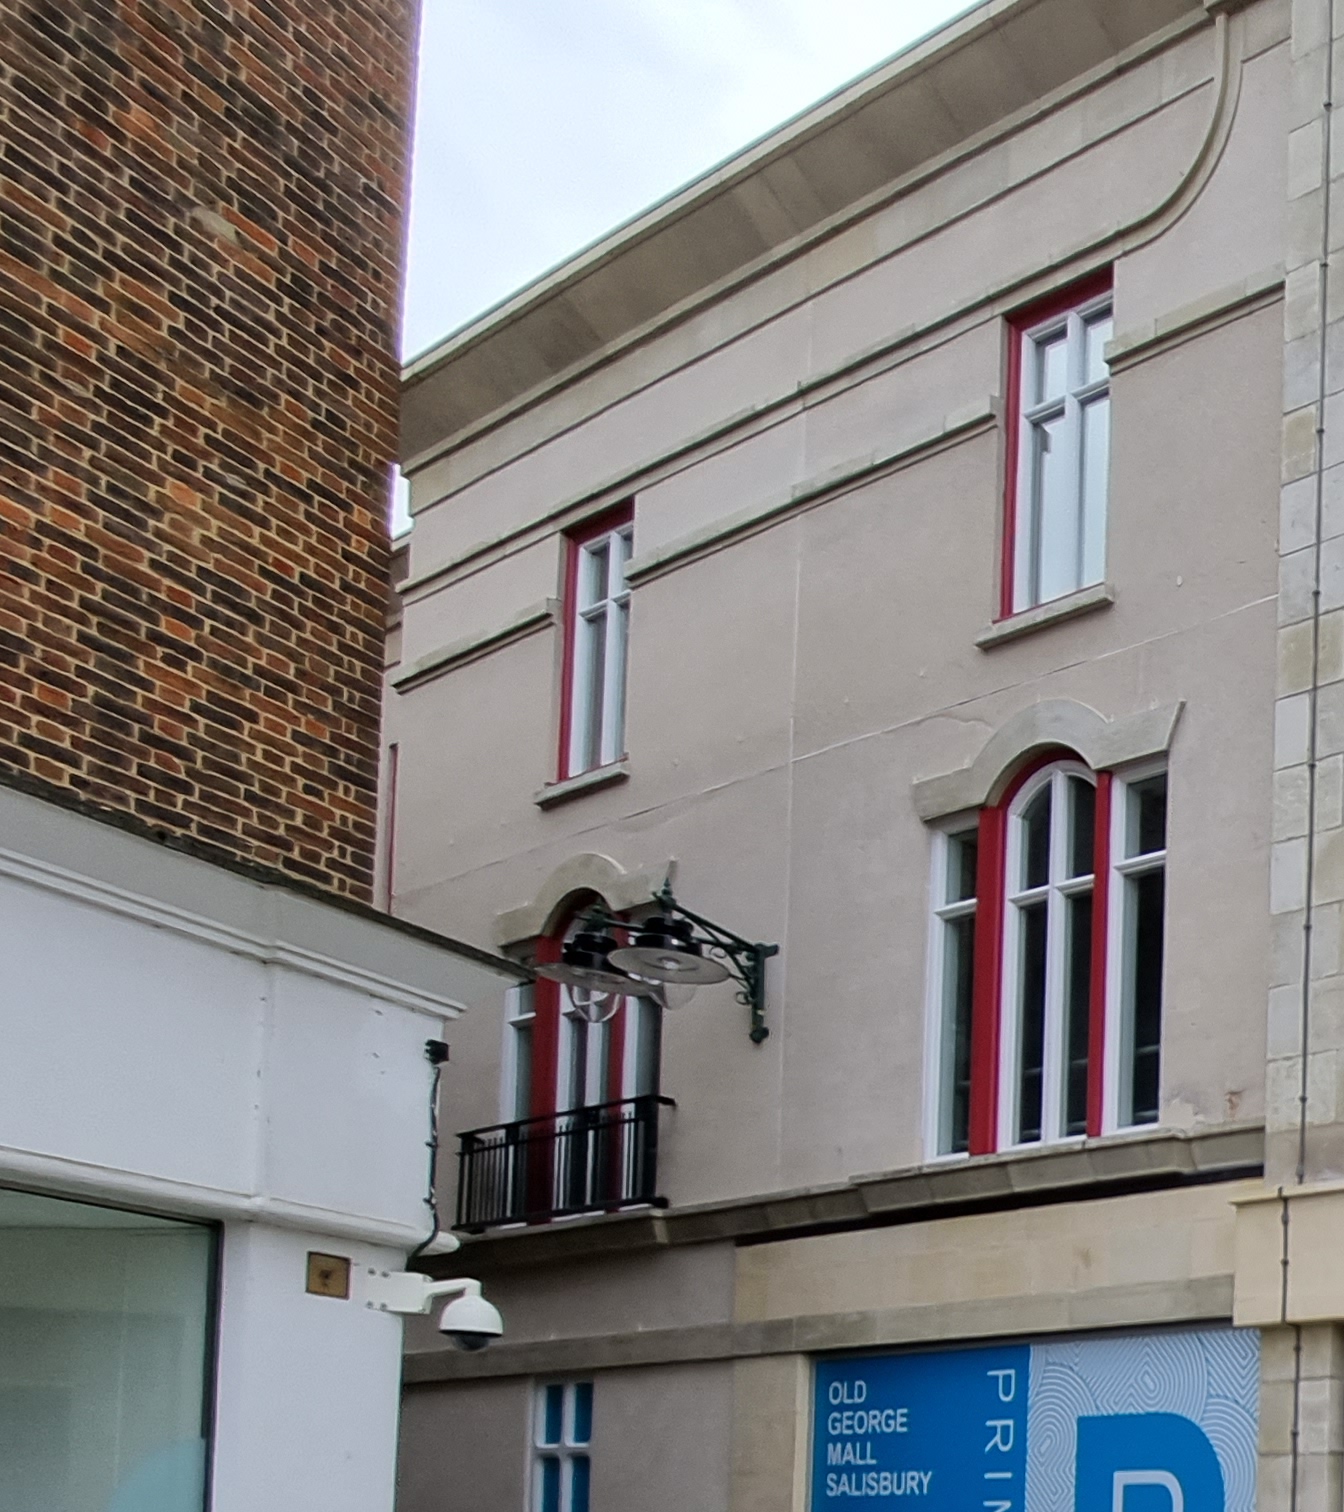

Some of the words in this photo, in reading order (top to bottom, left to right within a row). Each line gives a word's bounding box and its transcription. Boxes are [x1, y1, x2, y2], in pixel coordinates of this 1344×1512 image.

[828, 1380, 867, 1405] OLD
[827, 1408, 908, 1435] GEORGE
[826, 1441, 877, 1466] MALL
[825, 1470, 932, 1497] SALISBURY
